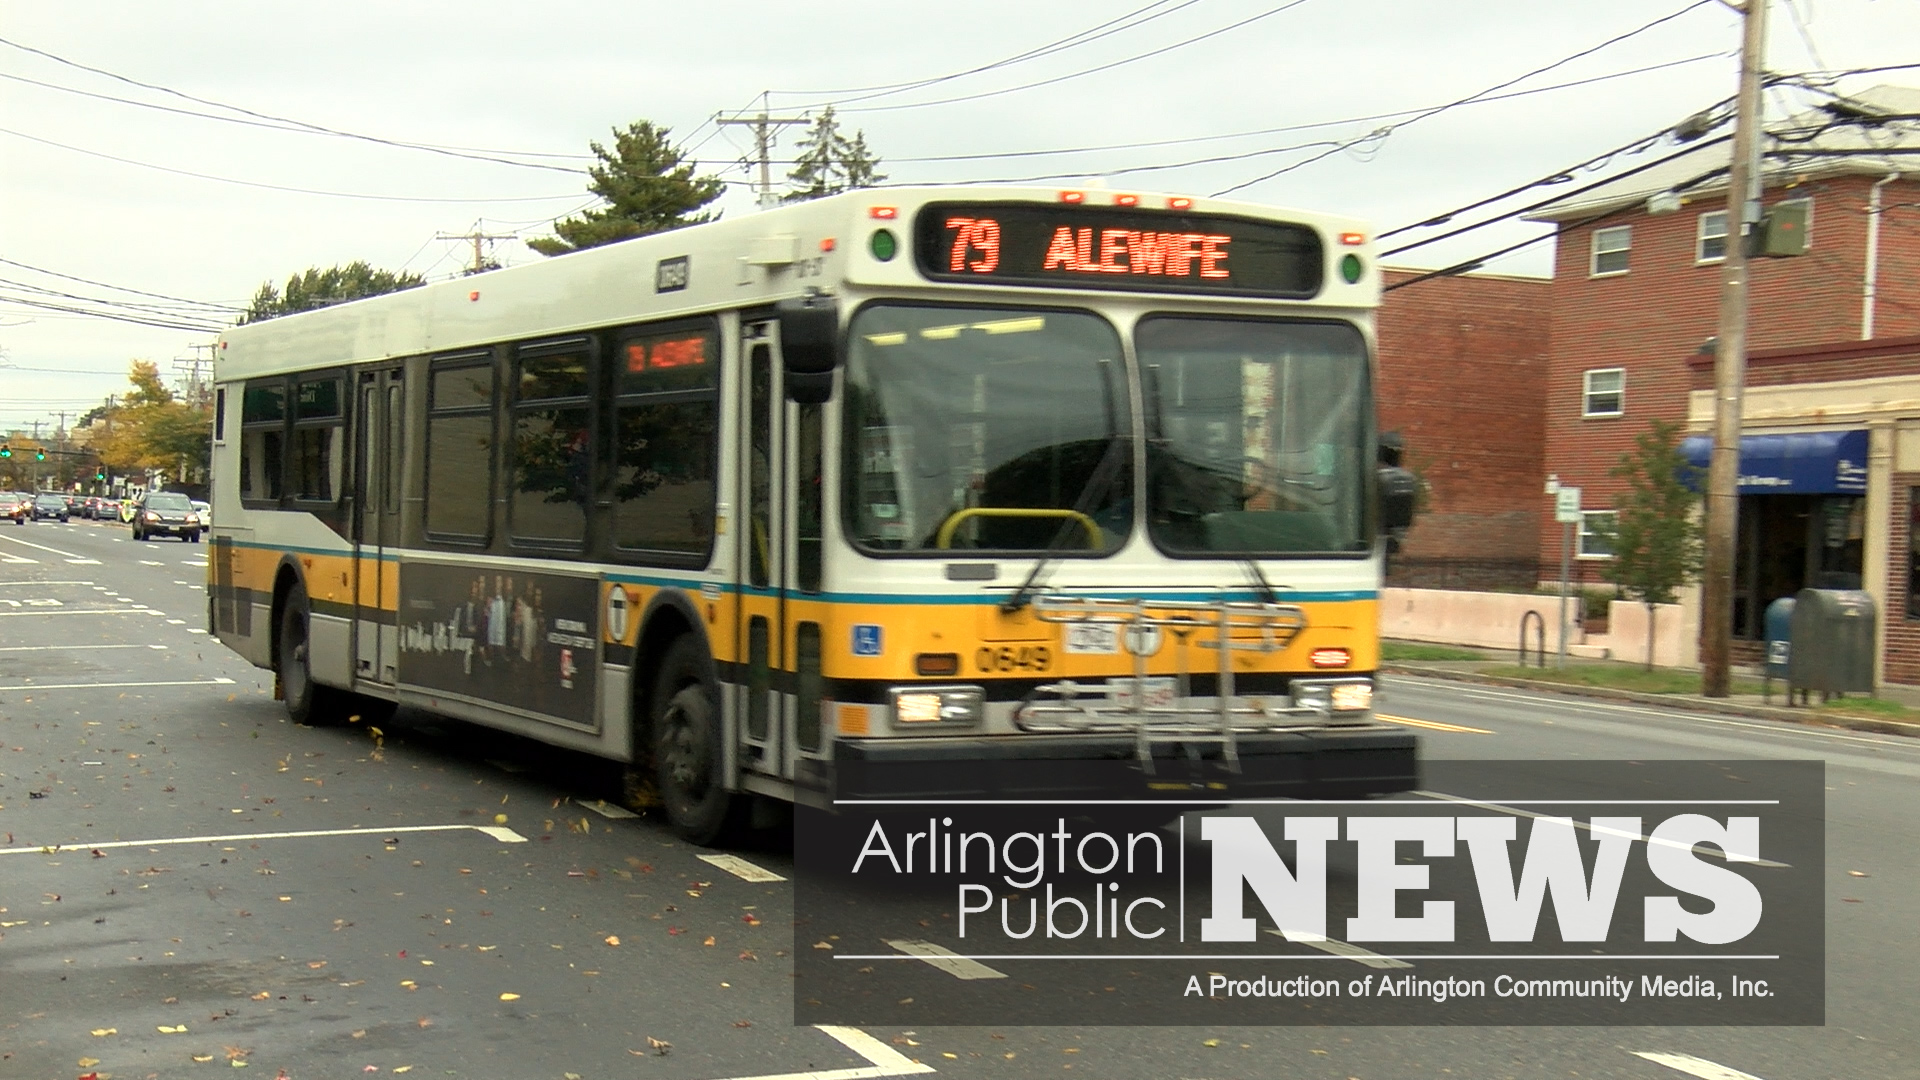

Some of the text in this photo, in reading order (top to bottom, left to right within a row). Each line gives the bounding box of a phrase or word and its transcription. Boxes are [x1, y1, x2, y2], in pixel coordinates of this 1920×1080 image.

[946, 217, 1231, 278] 79 ALEWIFE
[977, 646, 1052, 672] 0649
